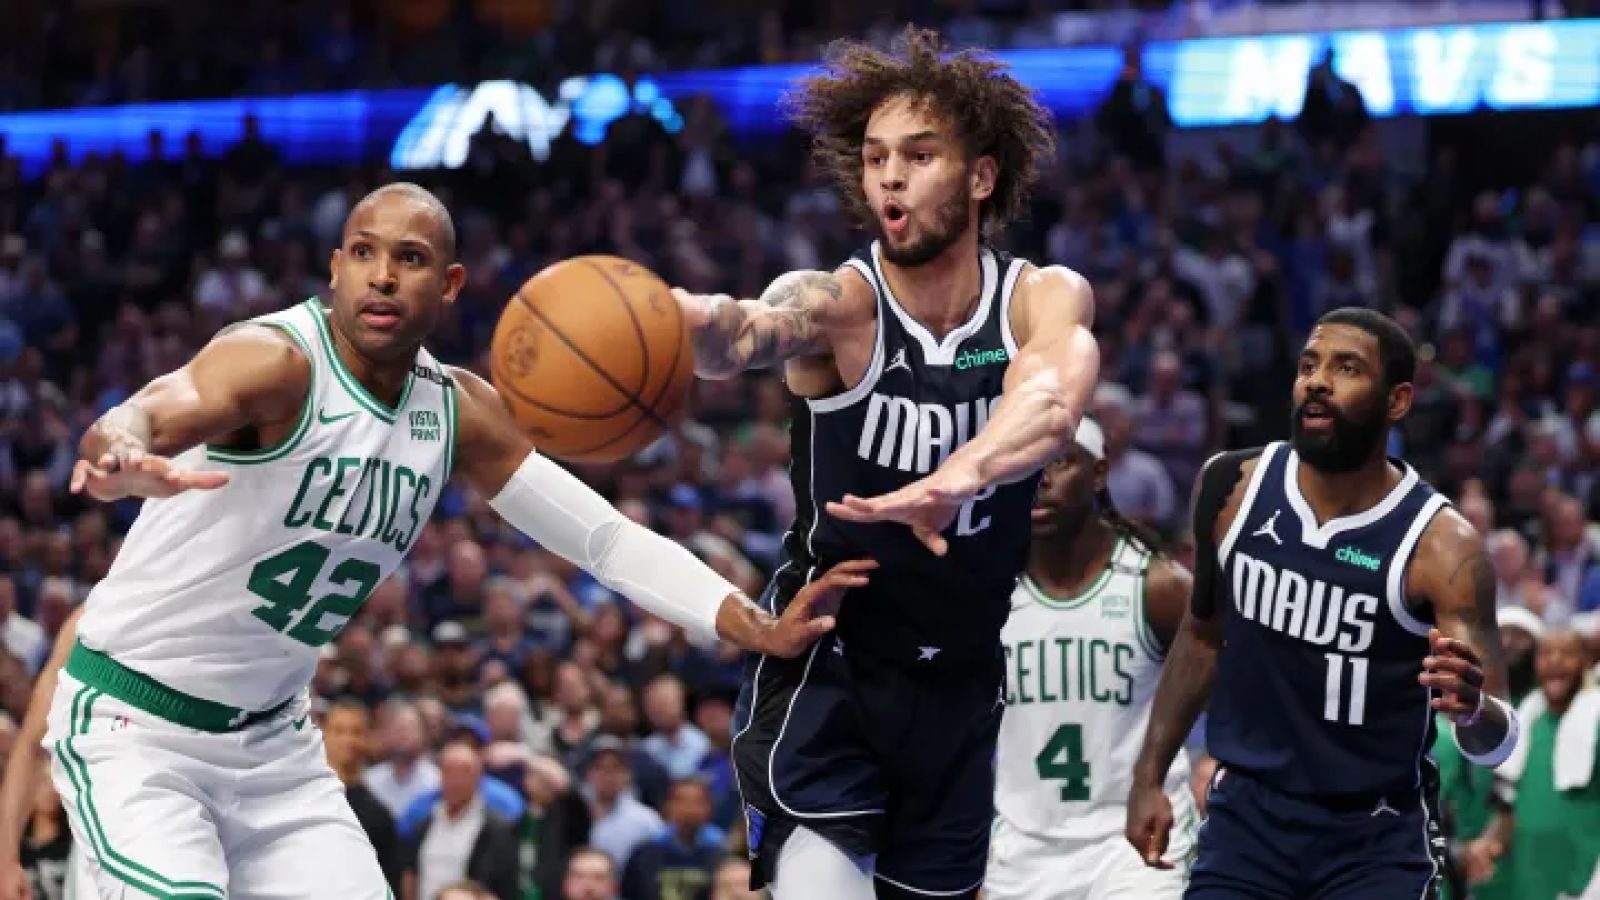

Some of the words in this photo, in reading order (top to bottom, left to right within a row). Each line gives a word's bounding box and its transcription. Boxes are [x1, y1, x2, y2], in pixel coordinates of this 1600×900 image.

[955, 348, 1006, 370] chime
[284, 457, 430, 552] CELTICS
[247, 540, 381, 647] 42
[1335, 547, 1381, 571] chime
[1233, 551, 1379, 652] MAVS
[1324, 653, 1369, 725] 11
[1035, 724, 1091, 802] 4
